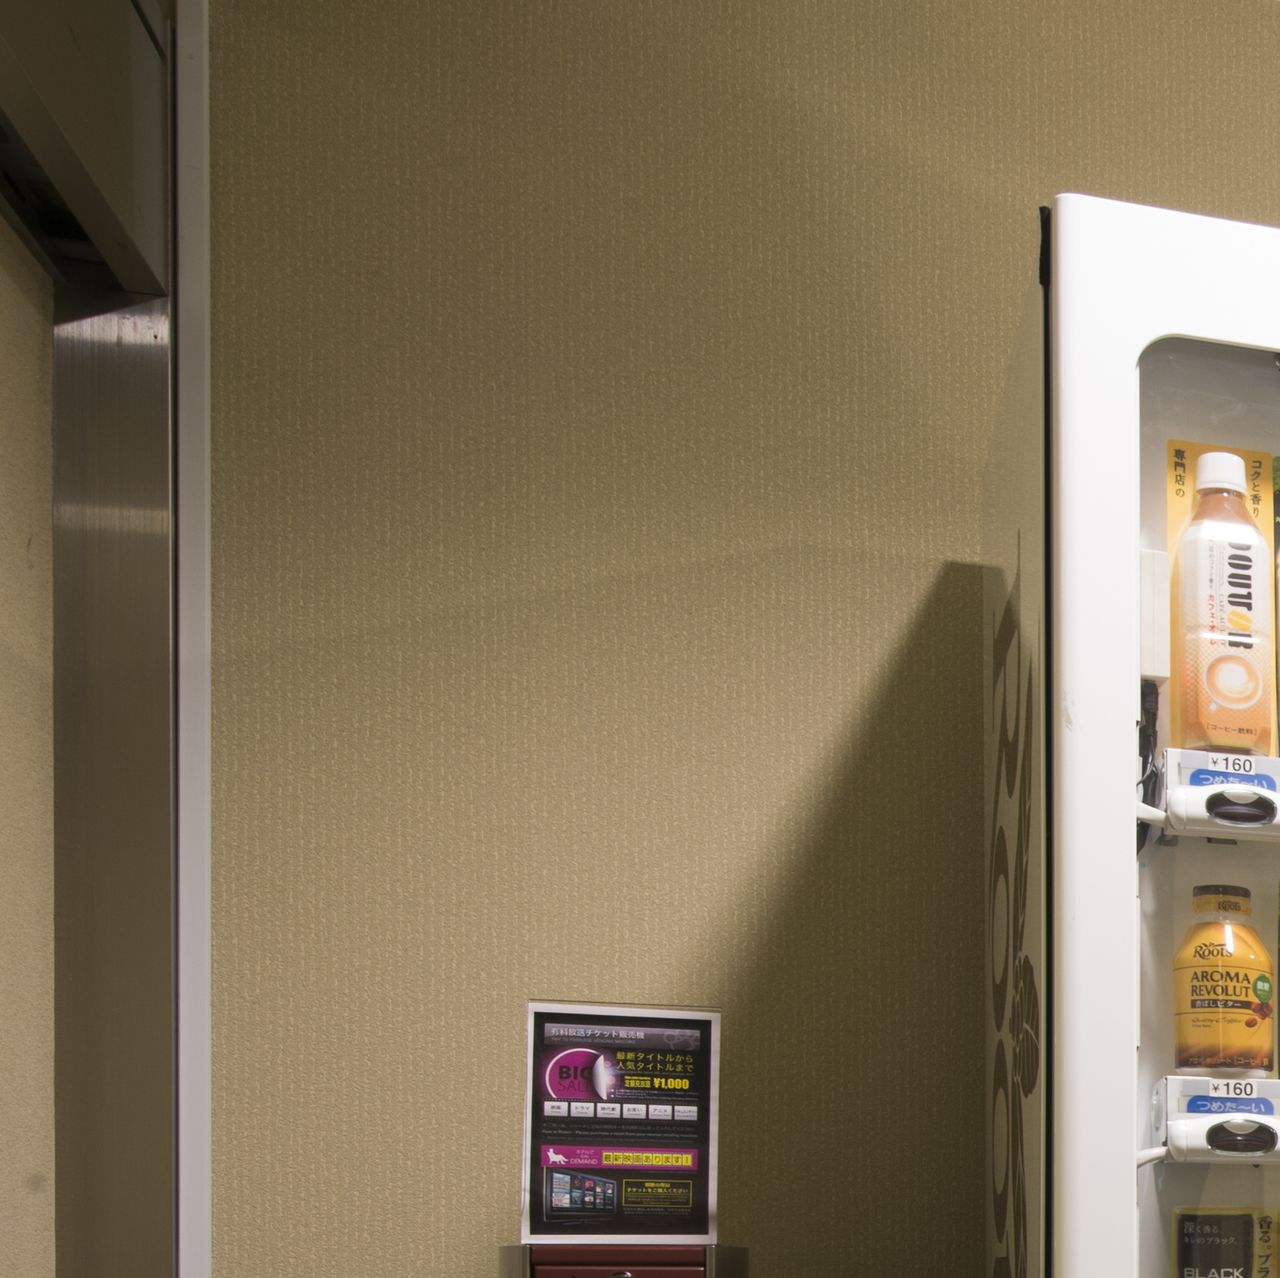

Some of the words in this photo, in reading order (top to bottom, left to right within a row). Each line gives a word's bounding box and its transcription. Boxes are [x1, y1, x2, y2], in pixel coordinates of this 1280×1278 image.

[1173, 448, 1186, 498] 専門店の
[1249, 459, 1263, 519] コクと香り
[1190, 970, 1251, 984] AROMA
